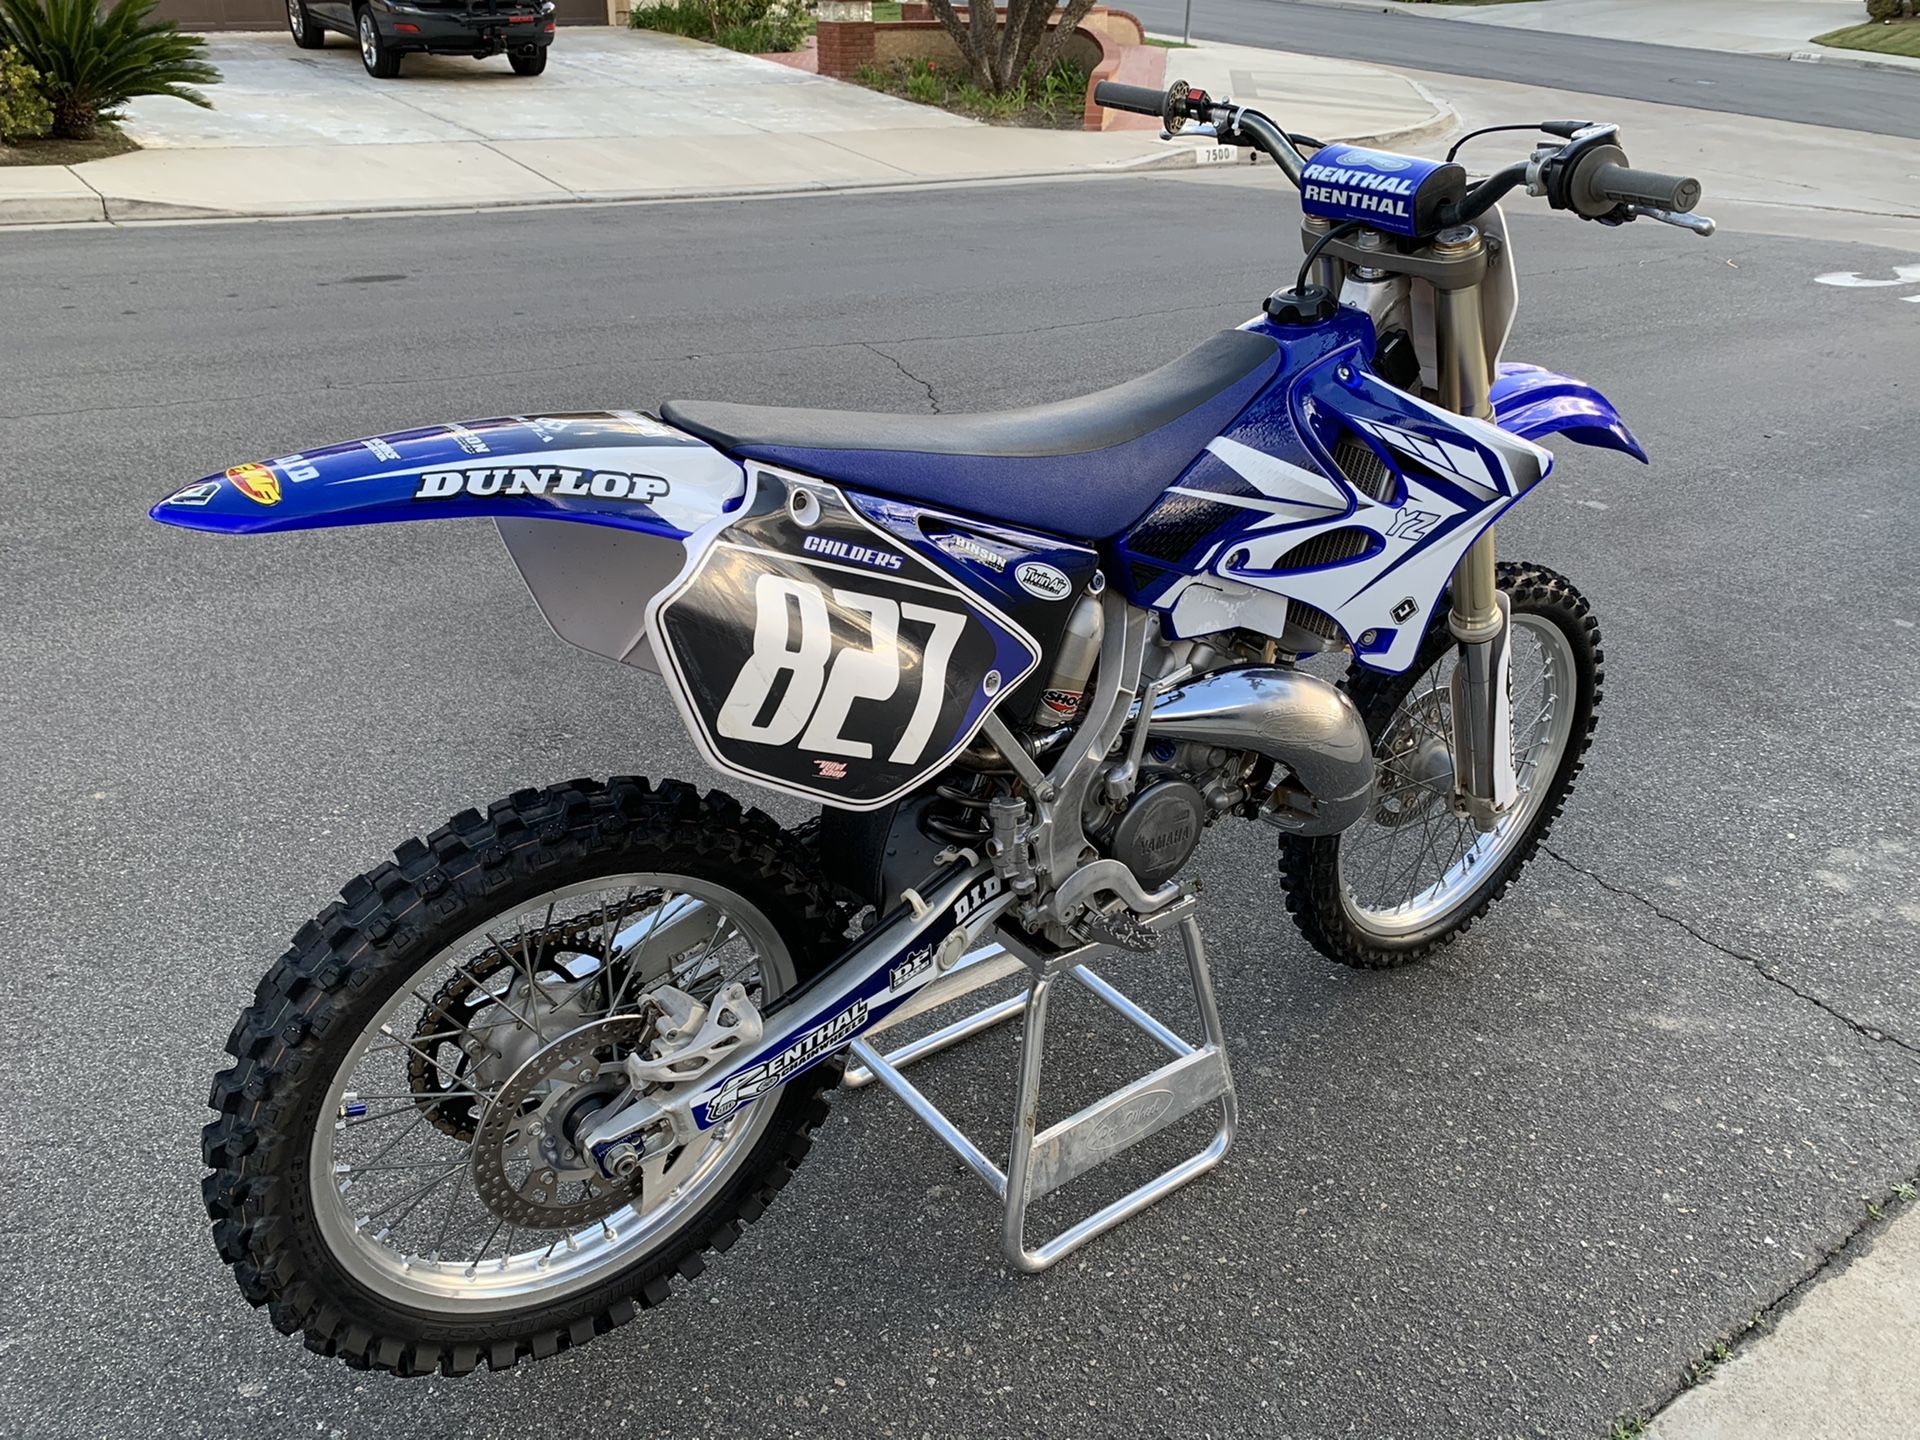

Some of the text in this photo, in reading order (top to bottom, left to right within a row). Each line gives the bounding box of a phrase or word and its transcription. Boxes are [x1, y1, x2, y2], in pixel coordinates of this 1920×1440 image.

[1205, 147, 1231, 162] 7500
[1303, 163, 1415, 195] RENTHAL
[1304, 184, 1410, 218] RENTHAL
[414, 467, 671, 503] DUNLOP
[1384, 487, 1442, 541] YZ
[803, 535, 904, 570] CHILDERS
[955, 537, 1008, 568] HINSON
[715, 573, 968, 766] 827
[1140, 825, 1190, 854] YAMAHA
[893, 950, 930, 981] DP
[707, 999, 868, 1120] RENTHAL
[780, 1014, 867, 1078] CHAINWHEELS
